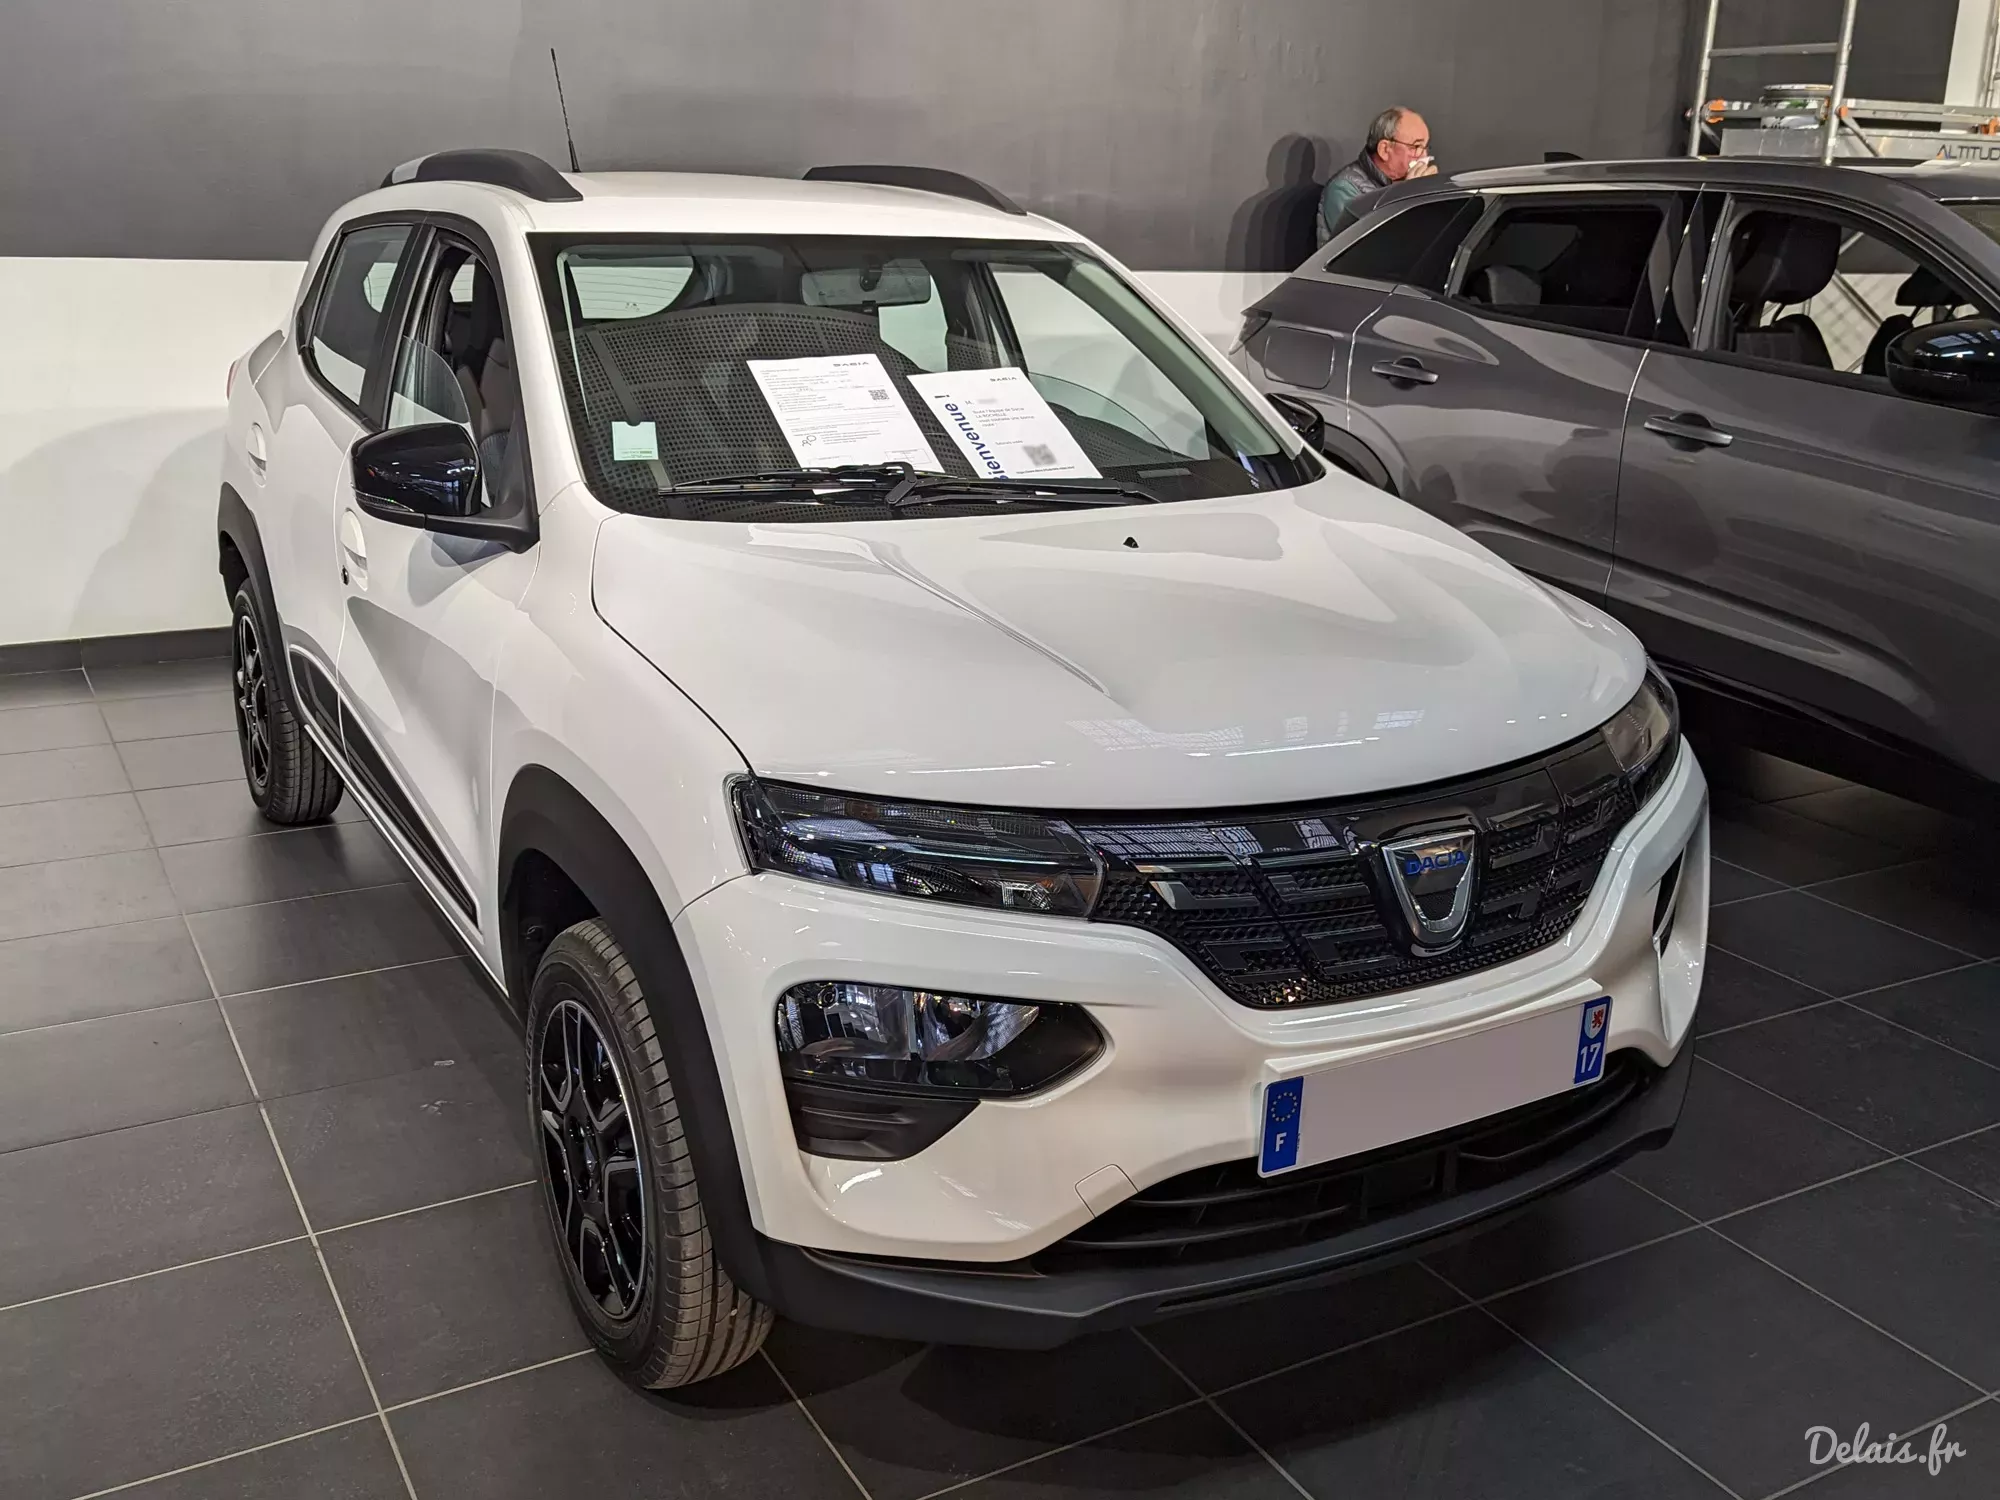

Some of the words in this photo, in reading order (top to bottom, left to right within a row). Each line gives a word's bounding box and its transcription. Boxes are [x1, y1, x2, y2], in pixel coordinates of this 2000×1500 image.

[1405, 850, 1468, 876] DACIA
[1580, 1042, 1602, 1074] 17
[1275, 1131, 1287, 1152] F
